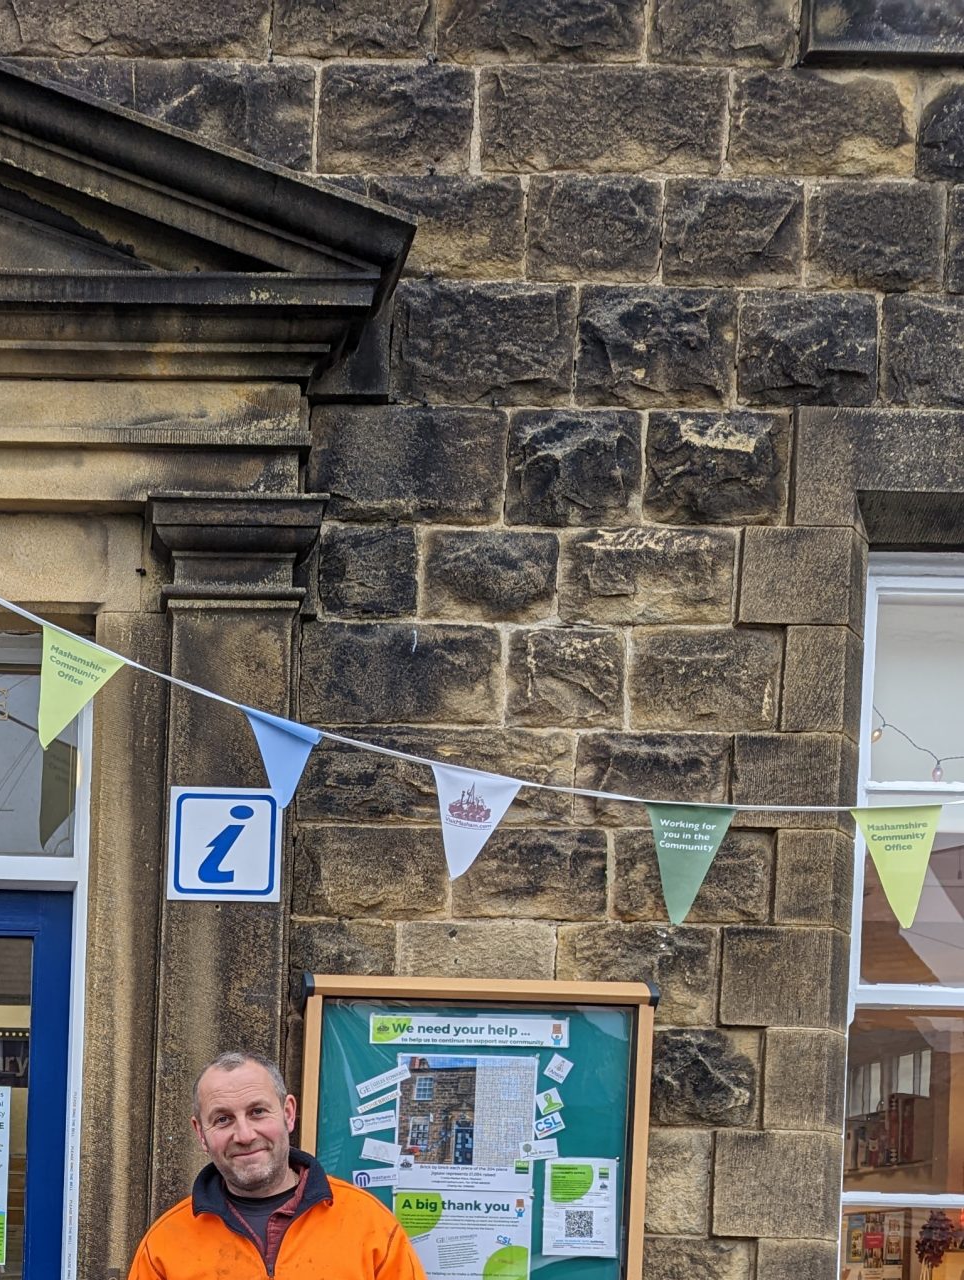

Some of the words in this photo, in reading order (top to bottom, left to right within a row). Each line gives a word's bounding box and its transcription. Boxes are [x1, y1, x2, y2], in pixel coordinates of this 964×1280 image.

[50, 644, 107, 674] Mashamshire
[49, 655, 101, 682] Community
[57, 670, 84, 686] Office
[659, 818, 700, 831] Working
[701, 822, 717, 831] for
[867, 821, 929, 831] Mashamshire
[663, 831, 680, 840] you
[694, 832, 710, 841] the
[870, 831, 927, 842] Community
[659, 840, 714, 853] Community
[884, 843, 913, 852] Office
[392, 1023, 414, 1034] We
[417, 1024, 450, 1034] need
[452, 1026, 486, 1036] your
[487, 1024, 518, 1038] help
[535, 1116, 562, 1132] CSL
[402, 1199, 412, 1210] A
[416, 1199, 438, 1212] big
[441, 1200, 482, 1212] thank
[484, 1202, 510, 1214] you
